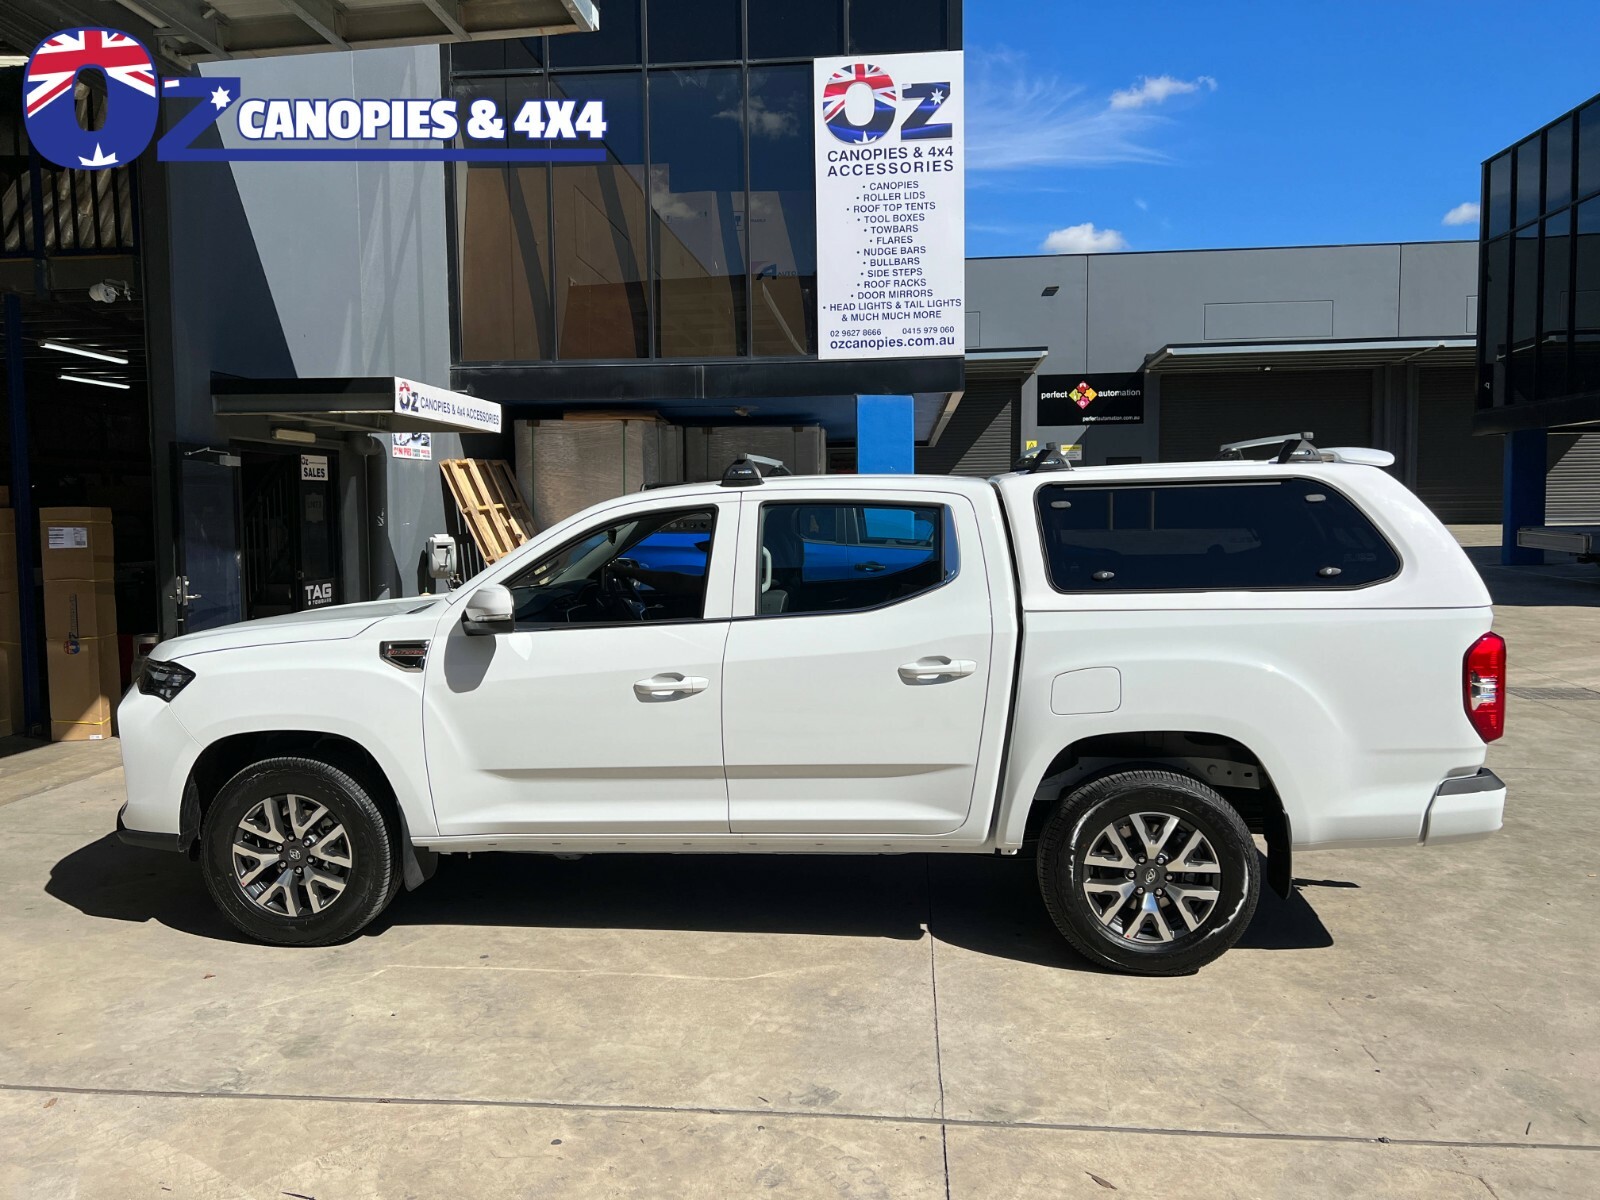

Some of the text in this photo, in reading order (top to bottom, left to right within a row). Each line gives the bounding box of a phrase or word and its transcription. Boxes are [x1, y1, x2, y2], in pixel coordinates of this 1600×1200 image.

[827, 145, 953, 162] CANOPIES & 4x4
[827, 159, 954, 177] ACCESSORIES
[869, 181, 919, 191] CANOPIES
[863, 191, 926, 202] ROLLER LIDS
[853, 202, 936, 213] ROOF TOP TENTS
[864, 213, 925, 224] TOOL BOXES
[870, 224, 919, 234] TOWBARS
[876, 236, 913, 245] FLARES
[863, 246, 926, 256] NUDGE BARS
[869, 257, 920, 267] BULLBARS
[867, 268, 923, 277] SIDE STEPS
[863, 278, 927, 289] ROOF RACKS
[857, 289, 933, 300] DOOR MIRRORS
[829, 298, 962, 311] HEAD LIGHTS & TAIL LIGHTS
[841, 310, 942, 322] & MUCH MUCH MORE
[841, 329, 861, 337] 9627
[902, 327, 922, 335] 0415
[923, 326, 938, 334] 979
[830, 335, 955, 350] ozcanopies.com.au
[1041, 389, 1141, 400] perfect automation
[420, 396, 451, 414] CANOPIES
[452, 404, 456, 415] &
[466, 408, 499, 425] ACCESSORIES
[303, 467, 326, 478] SALES
[304, 583, 332, 600] TAG
